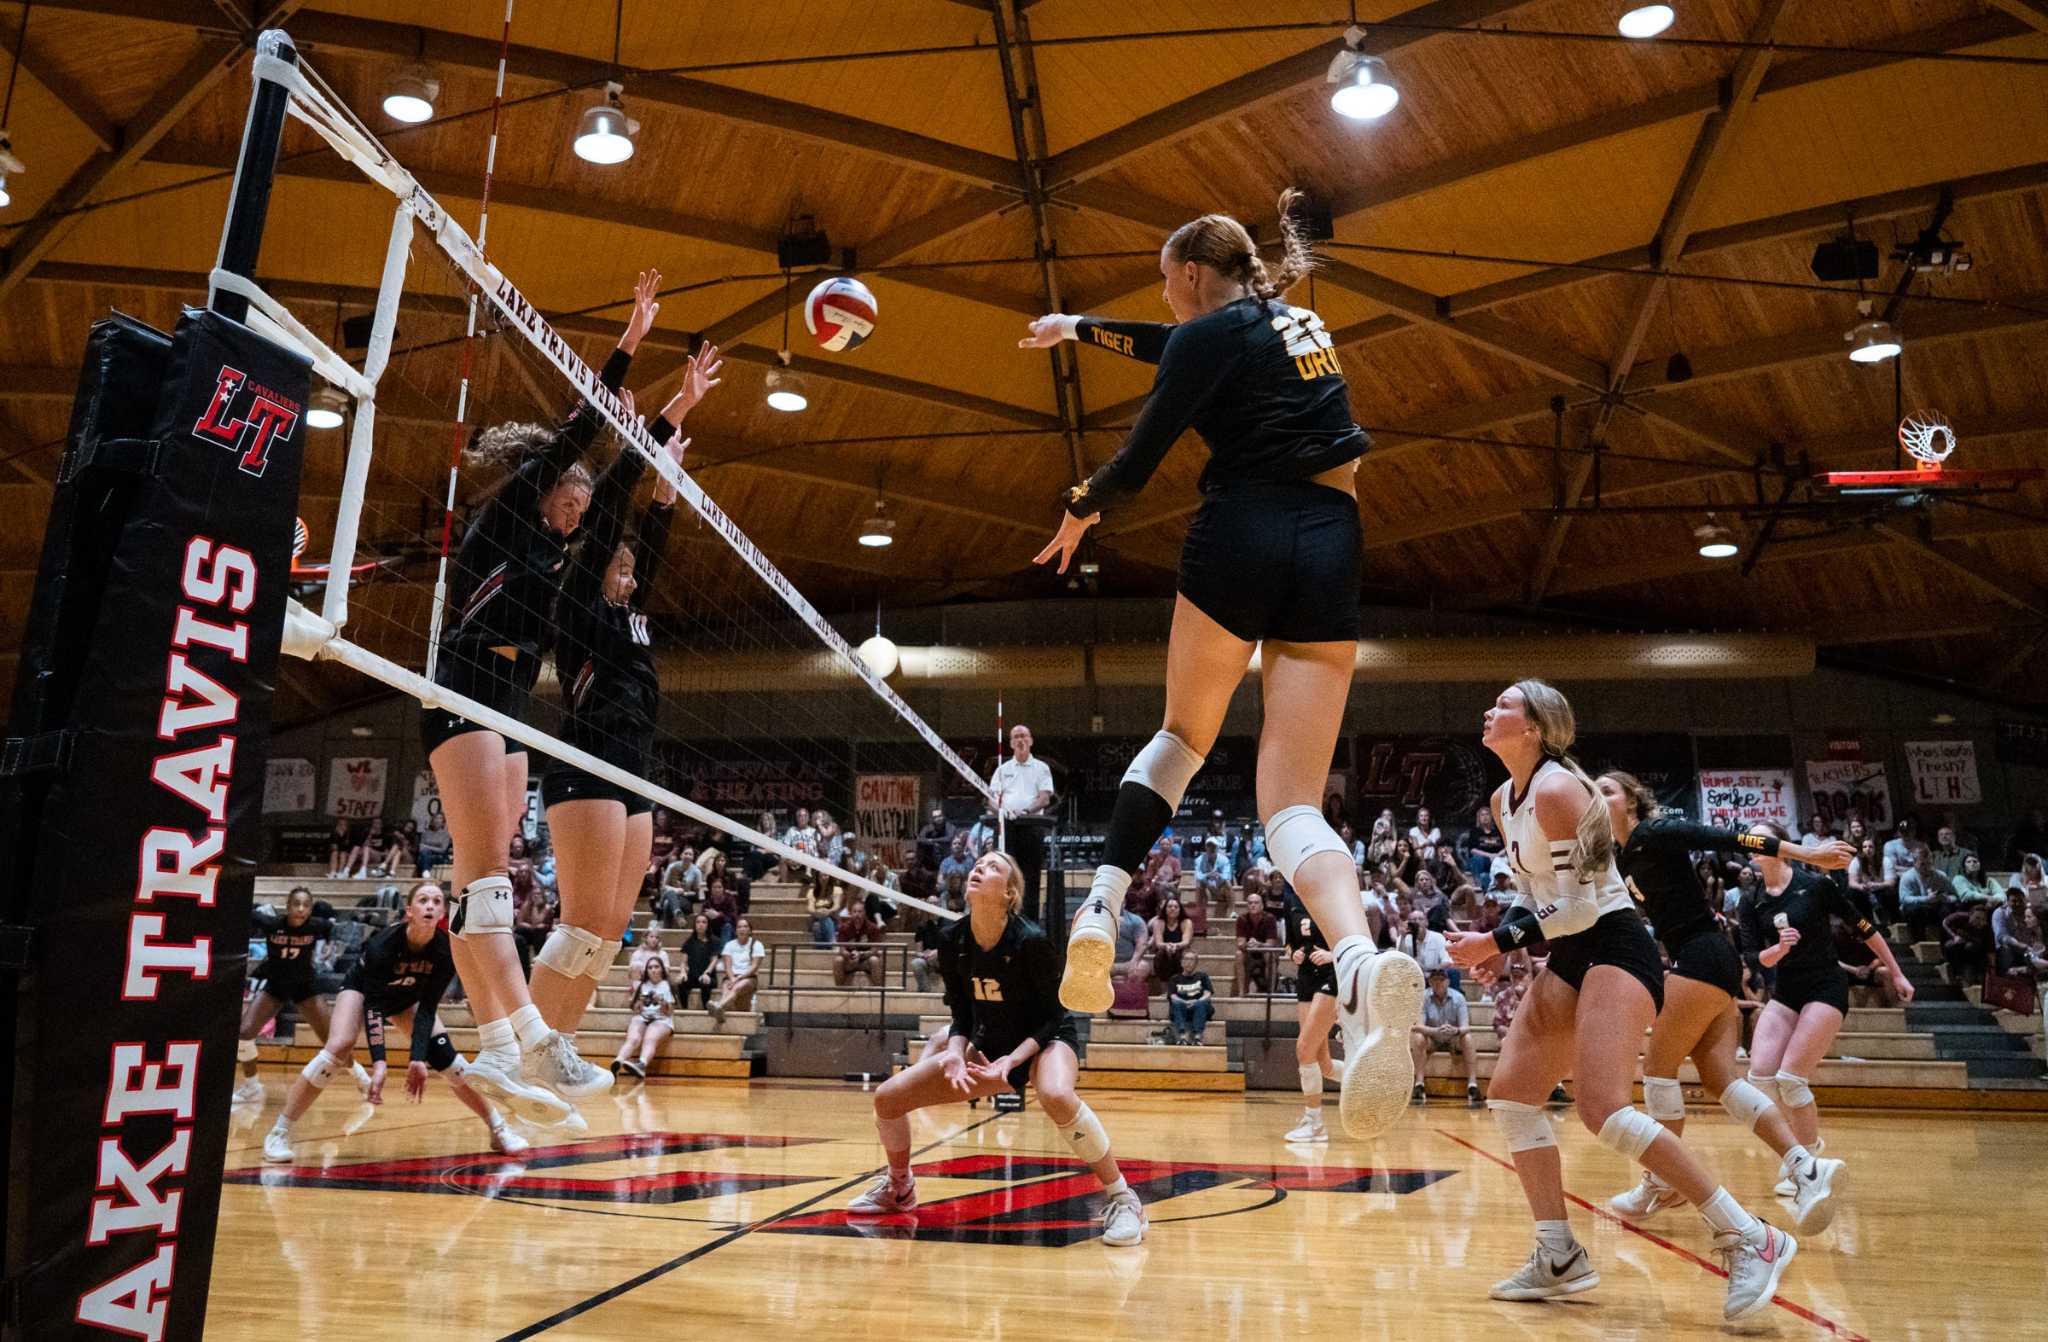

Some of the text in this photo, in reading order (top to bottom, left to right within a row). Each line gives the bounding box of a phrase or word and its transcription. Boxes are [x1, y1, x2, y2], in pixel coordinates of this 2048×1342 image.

[496, 277, 537, 333] LAKE
[541, 321, 588, 386] TRAVIS
[1090, 325, 1135, 357] TIGER
[247, 380, 302, 413] CAVALIERS
[192, 364, 299, 478] LT
[119, 535, 258, 1001] TRAVIS
[279, 946, 302, 961] 17
[971, 976, 1005, 1002] 12
